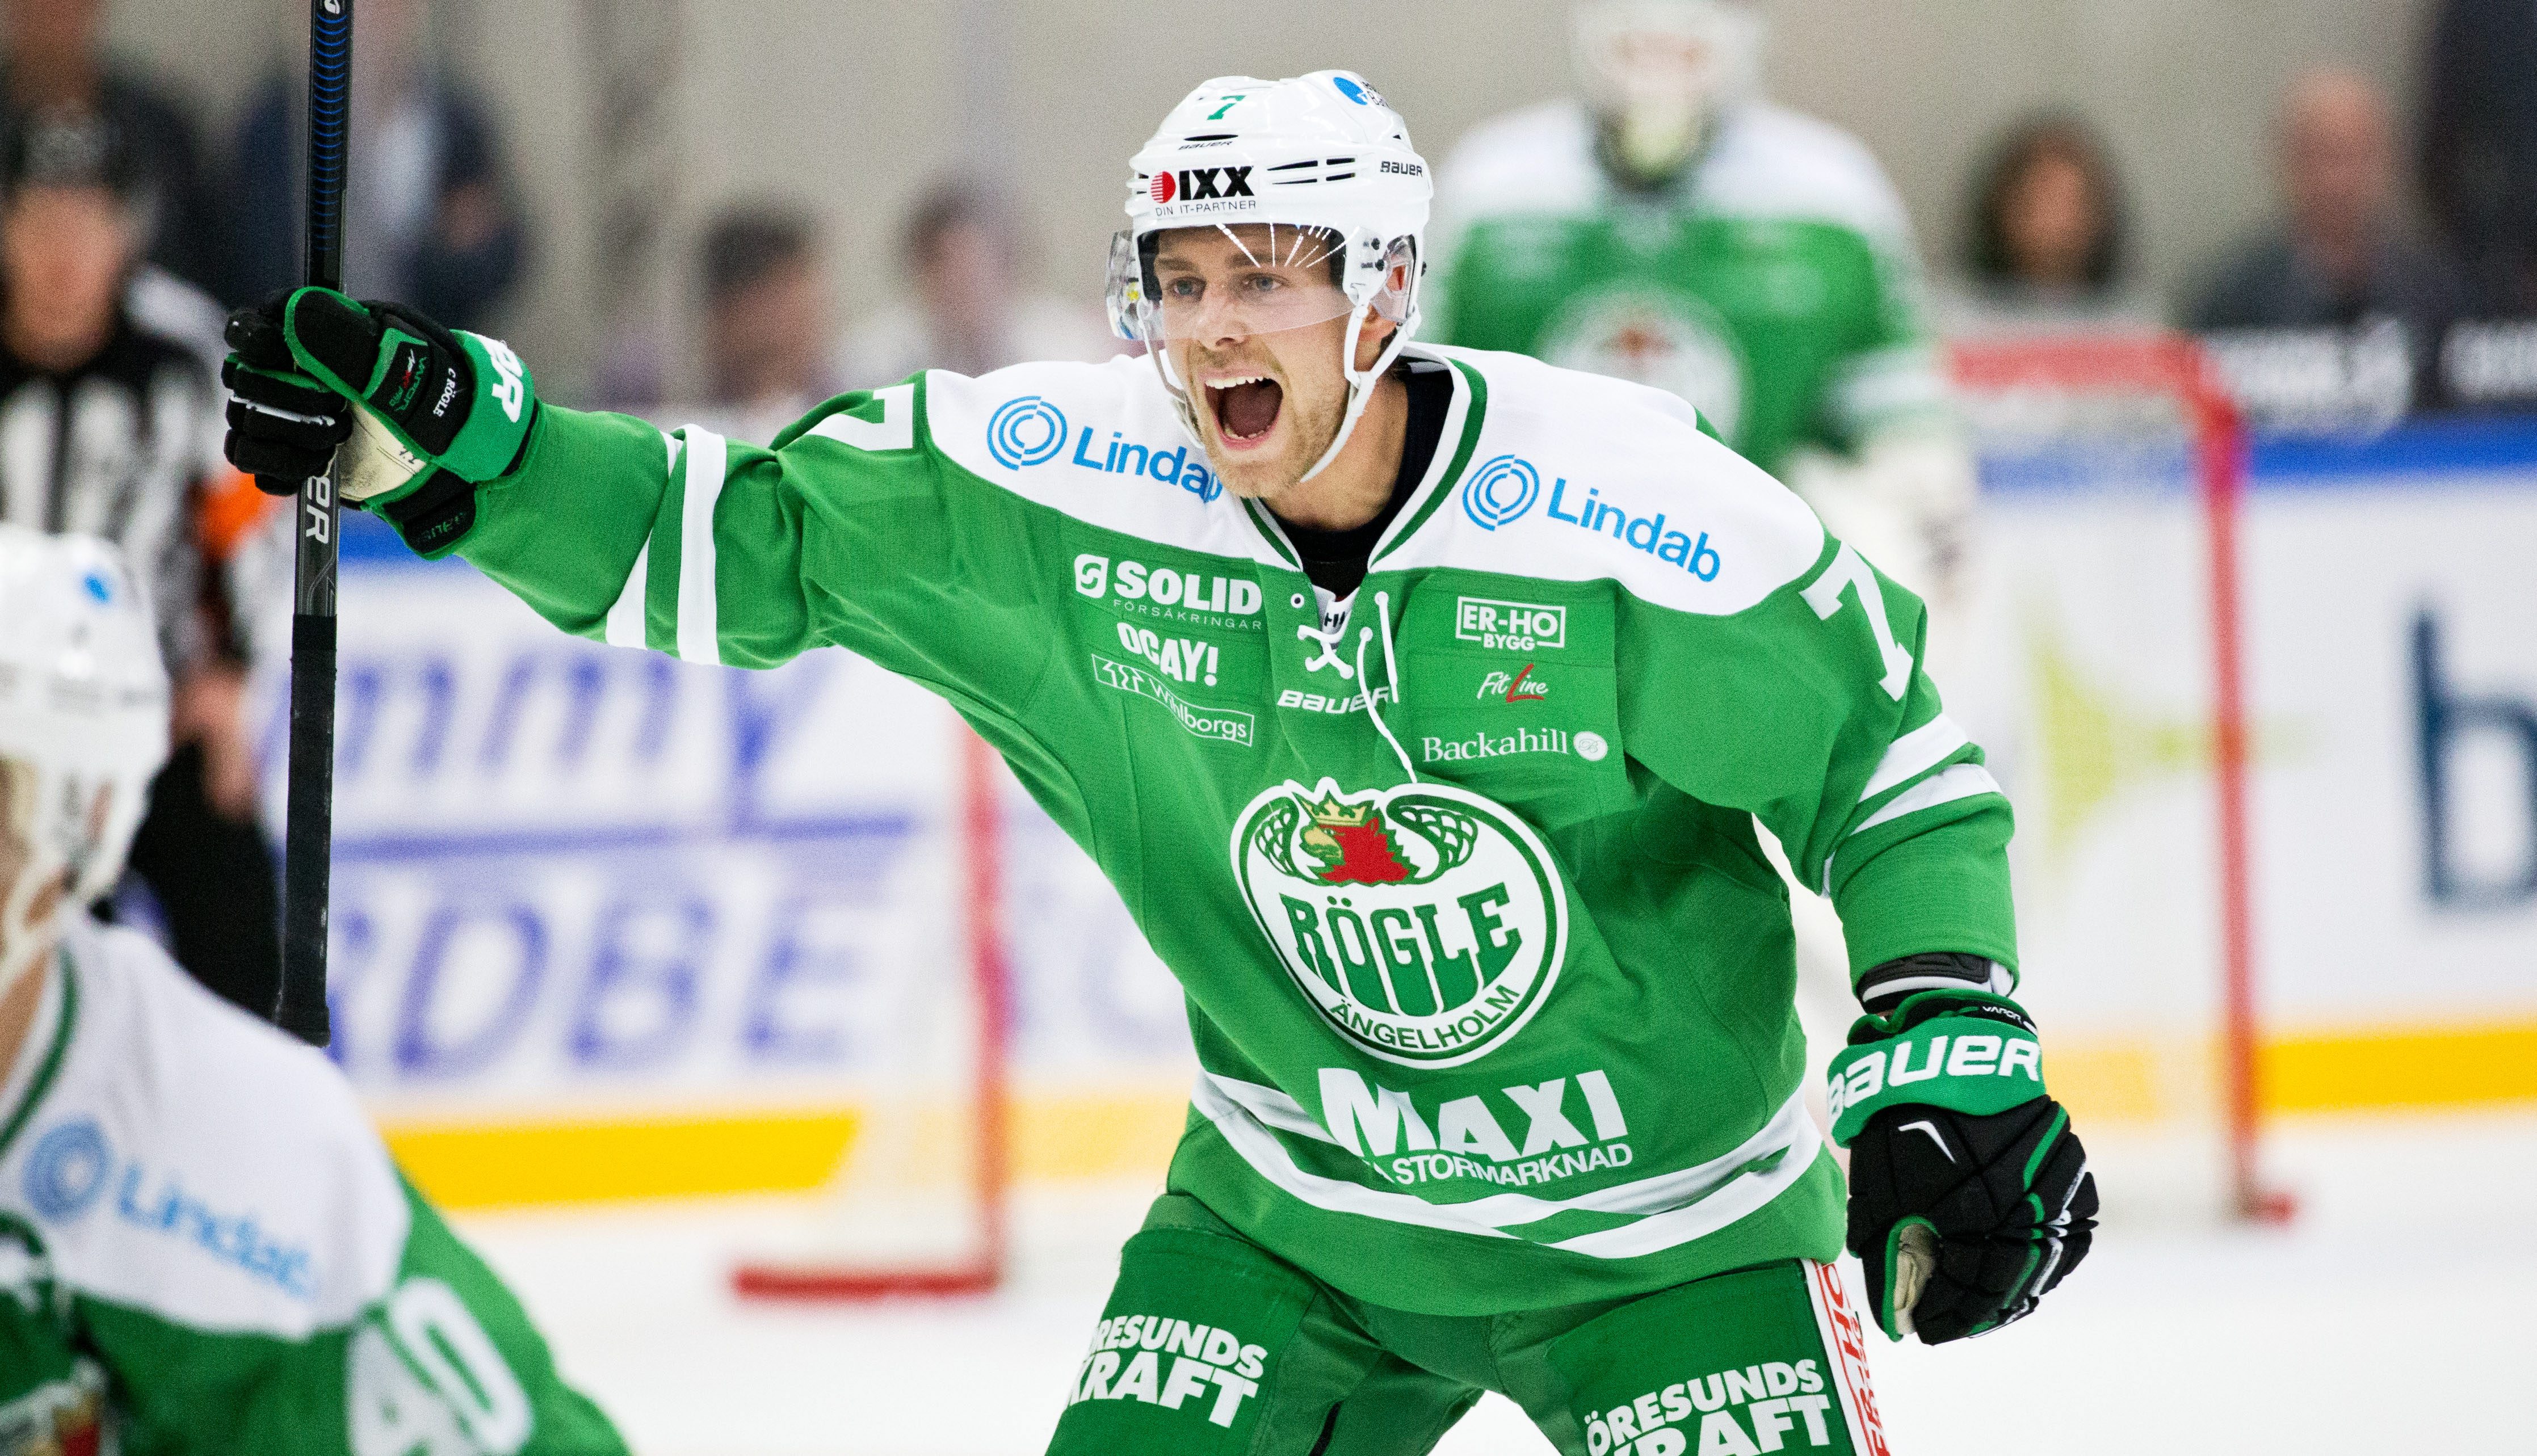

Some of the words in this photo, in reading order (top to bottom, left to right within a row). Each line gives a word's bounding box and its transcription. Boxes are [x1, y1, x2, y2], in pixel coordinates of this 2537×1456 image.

[1207, 95, 1246, 120] 7
[1155, 205, 1174, 217] DIN
[1179, 200, 1257, 214] IT-PARTNER
[1073, 426, 1223, 503] Lindab
[1547, 478, 1721, 582] Lindab
[1114, 561, 1262, 615] SOLID
[1114, 599, 1261, 630] FÖRSÄKRINGAR
[1464, 605, 1558, 637] ER-HO
[1484, 633, 1536, 651] BYGG
[1799, 541, 1913, 702] 7
[1117, 622, 1219, 687] OCAY!
[1149, 678, 1246, 740] Wihlborgs
[1422, 728, 1569, 762] Backahill
[1279, 882, 1523, 1016] RÖGLE
[1330, 984, 1520, 1050] ÄNGELHOLM
[1318, 1068, 1628, 1162] MAXI
[1393, 1143, 1633, 1186] STORMARKNAD
[1090, 1315, 1268, 1379] RESUNDS
[1584, 1359, 1824, 1456] ÖRESUNDS
[1614, 1394, 1831, 1456] RAFT
